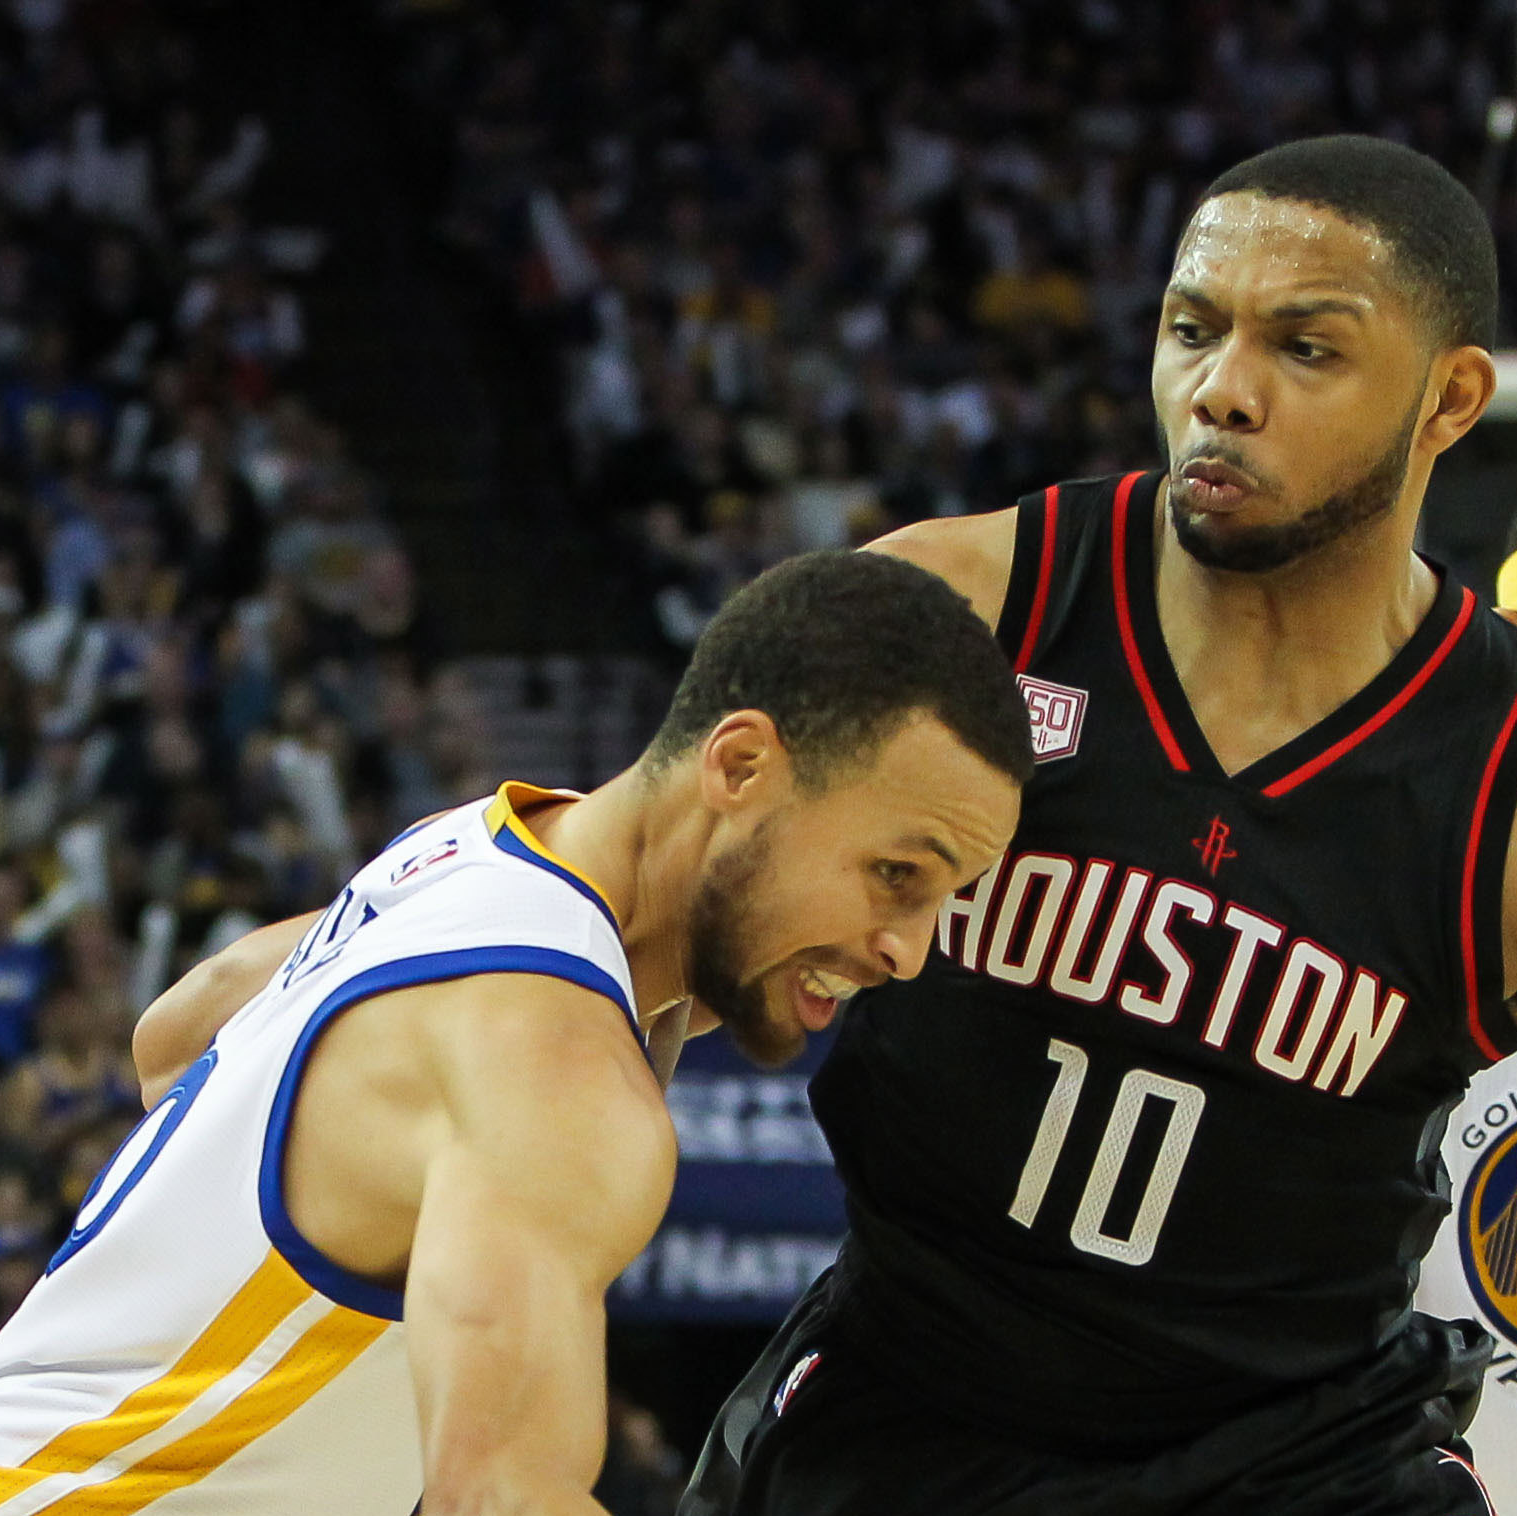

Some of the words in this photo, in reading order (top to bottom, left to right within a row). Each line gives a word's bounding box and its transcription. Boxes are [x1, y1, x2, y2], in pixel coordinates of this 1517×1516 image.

[1028, 690, 1072, 731] 50
[937, 851, 1410, 1099] HOUSTON
[1007, 1037, 1206, 1267] 10
